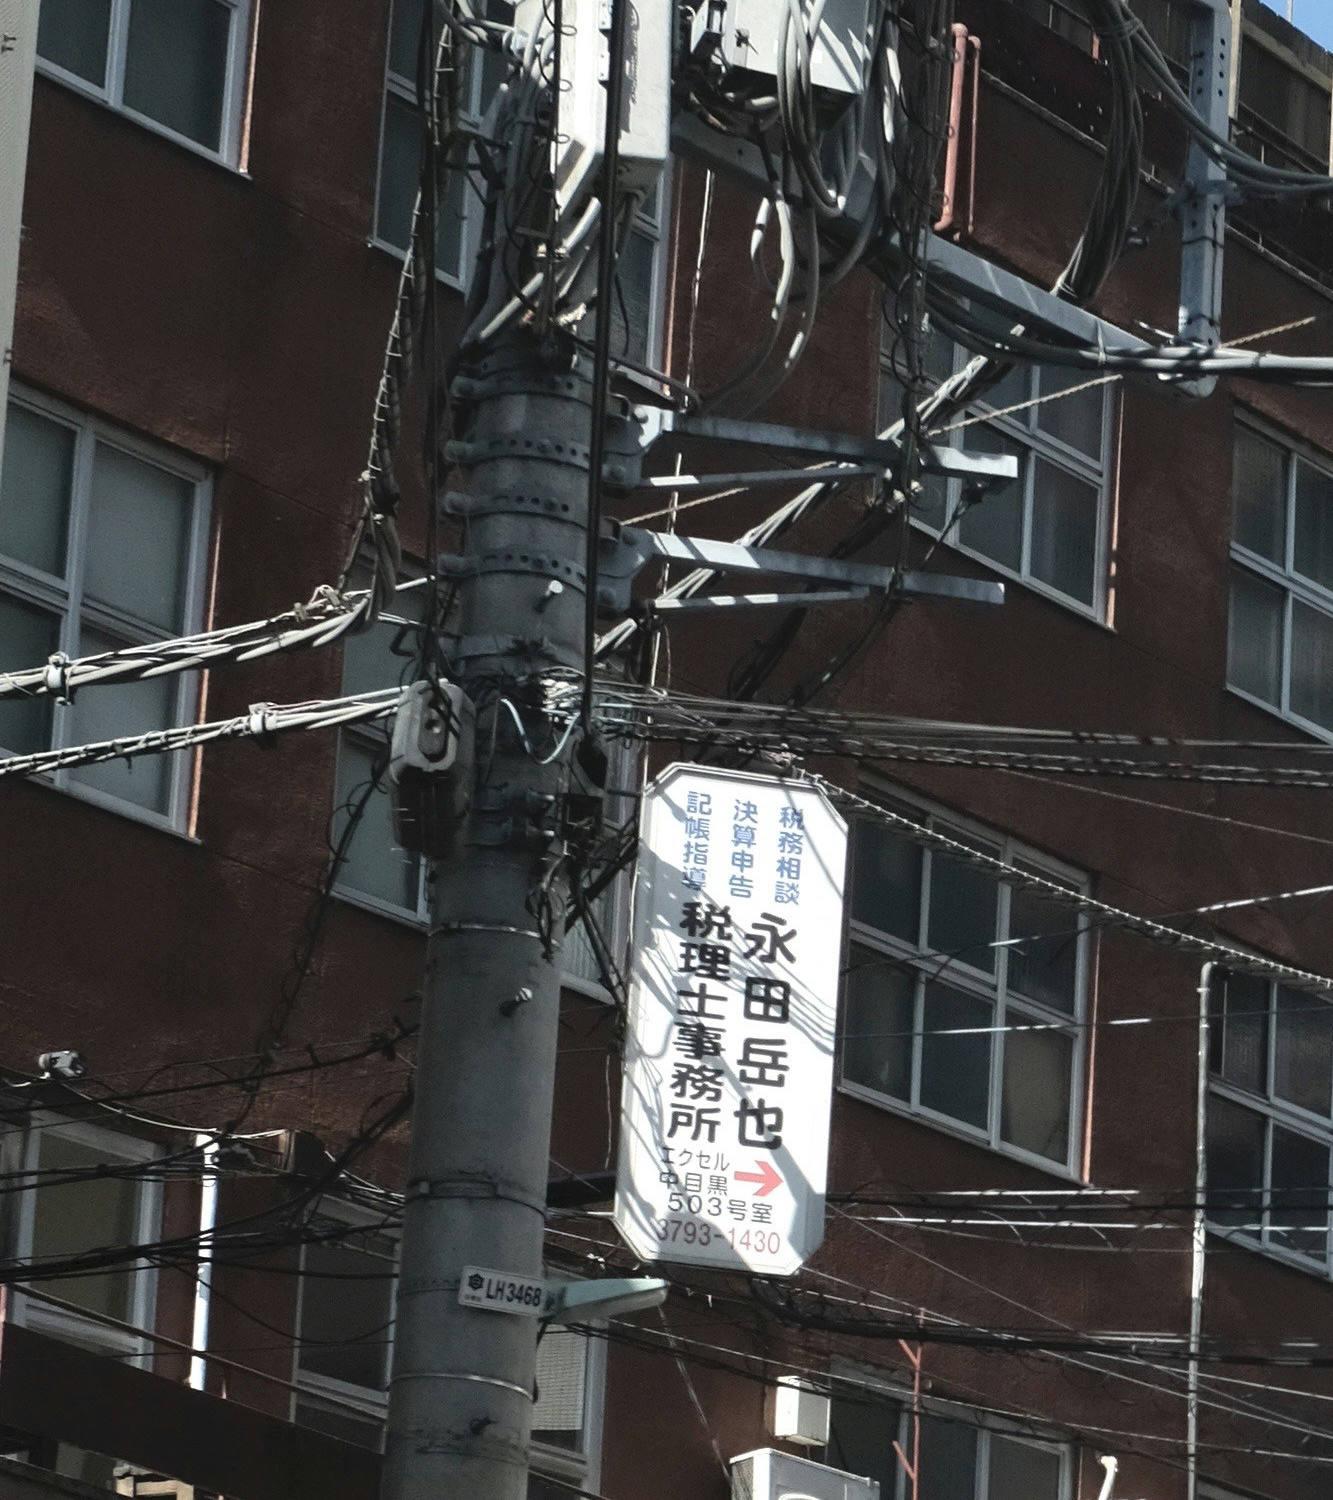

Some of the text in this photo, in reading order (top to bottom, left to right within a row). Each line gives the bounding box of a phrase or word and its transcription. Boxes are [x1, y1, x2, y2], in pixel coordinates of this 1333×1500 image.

[680, 790, 713, 891] 記帳指導
[728, 798, 759, 899] 決算申告
[775, 805, 805, 905] 税務相談
[666, 901, 733, 1143] 税理士事務所
[733, 911, 798, 1150] 永田岳也
[659, 1171, 728, 1196] 中目黒
[661, 1147, 730, 1171] エクセル
[667, 1192, 773, 1225] 503号室
[655, 1218, 781, 1255] 3793-1430
